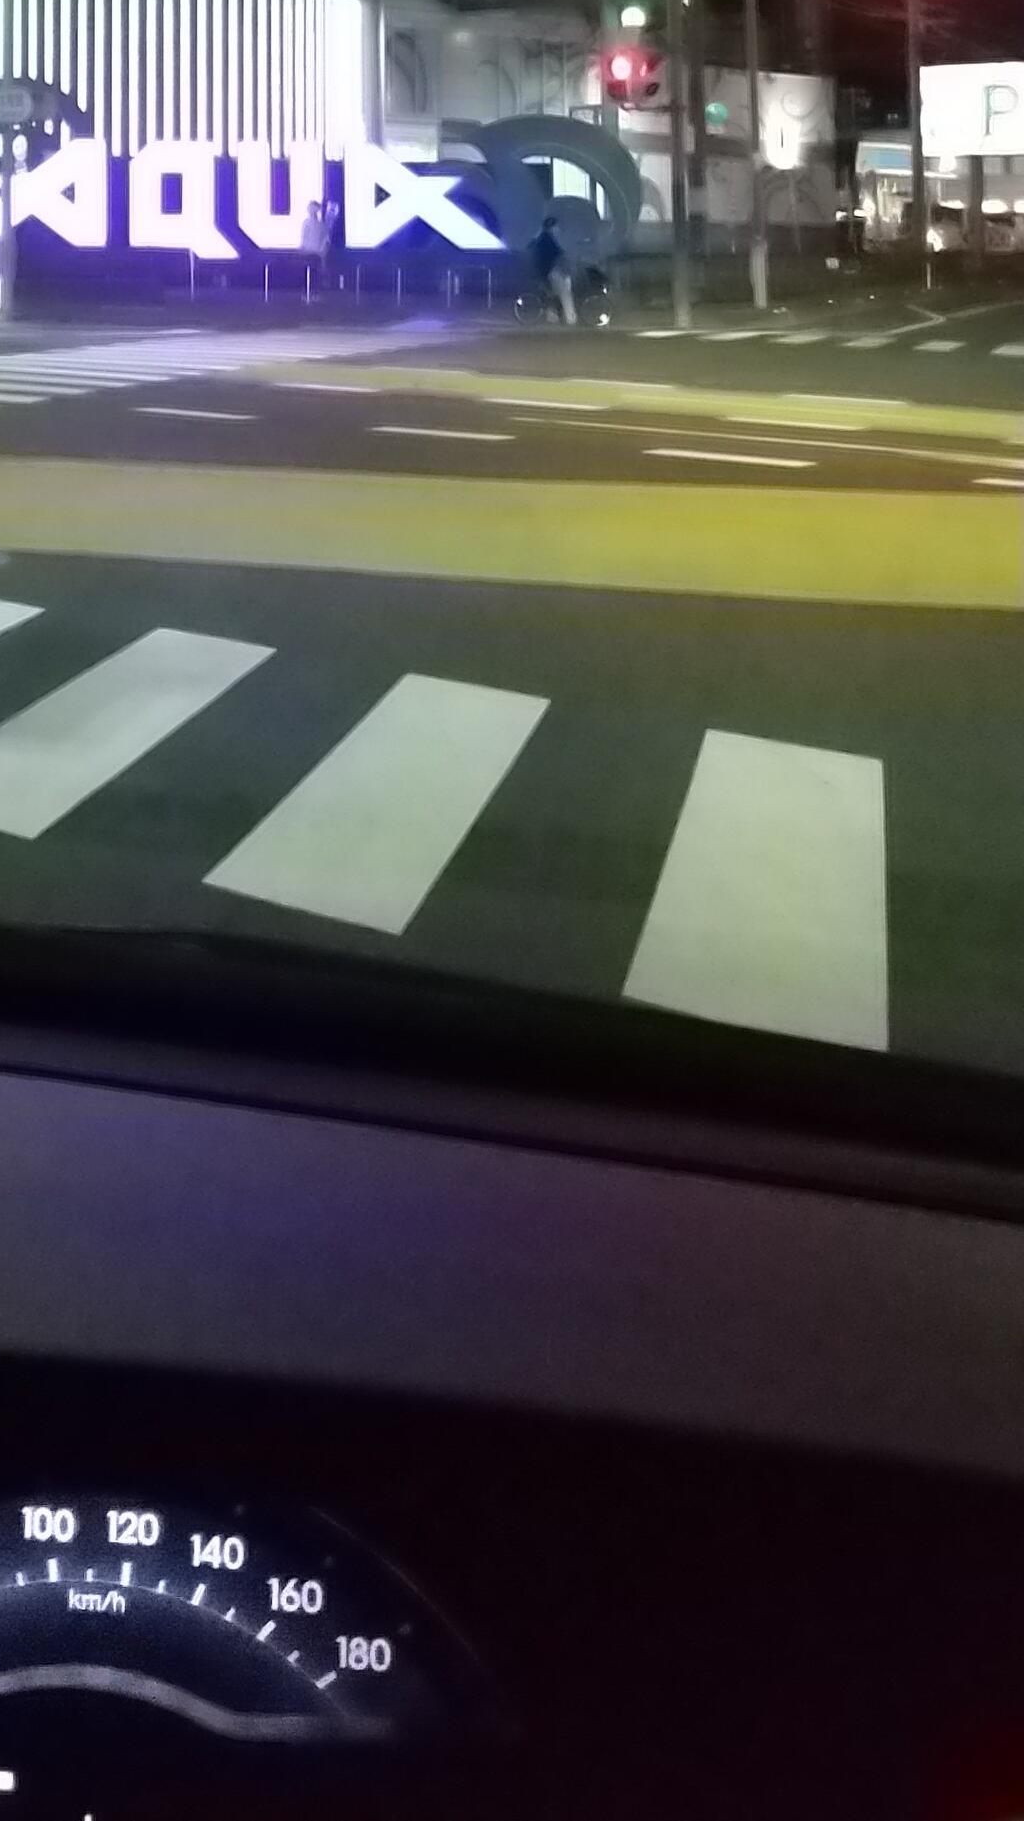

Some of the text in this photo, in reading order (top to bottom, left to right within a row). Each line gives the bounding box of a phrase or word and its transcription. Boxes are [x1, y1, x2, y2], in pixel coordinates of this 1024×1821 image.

[984, 84, 1018, 136] P
[20, 1505, 80, 1544] 100
[106, 1510, 162, 1547] 120
[189, 1534, 245, 1571] 140
[67, 1586, 127, 1614] km/h
[266, 1577, 324, 1614] 160
[335, 1635, 392, 1672] 180
